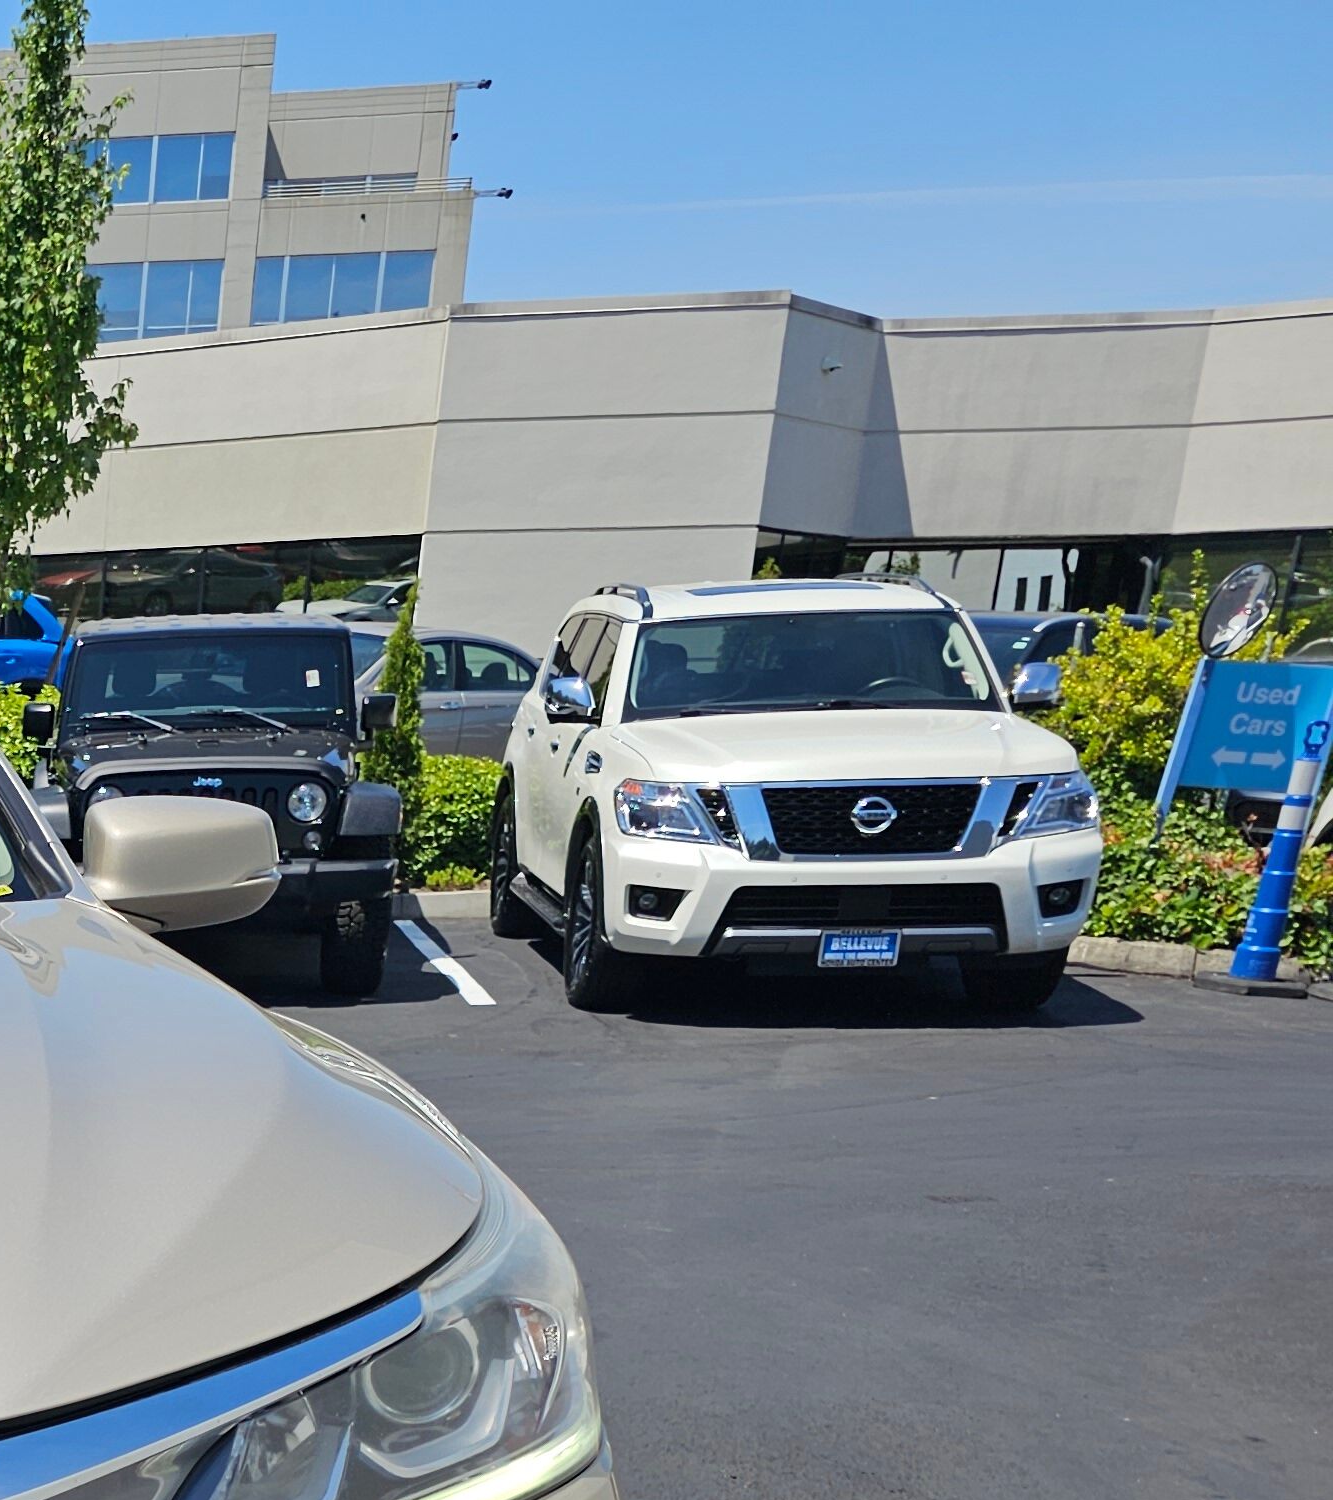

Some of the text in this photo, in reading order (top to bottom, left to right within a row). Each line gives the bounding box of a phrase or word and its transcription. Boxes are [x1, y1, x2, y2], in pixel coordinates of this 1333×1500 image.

[1235, 681, 1301, 706] Used
[1229, 713, 1286, 736] Cars
[193, 776, 222, 788] Jeep
[831, 937, 890, 950] BELLEVUE
